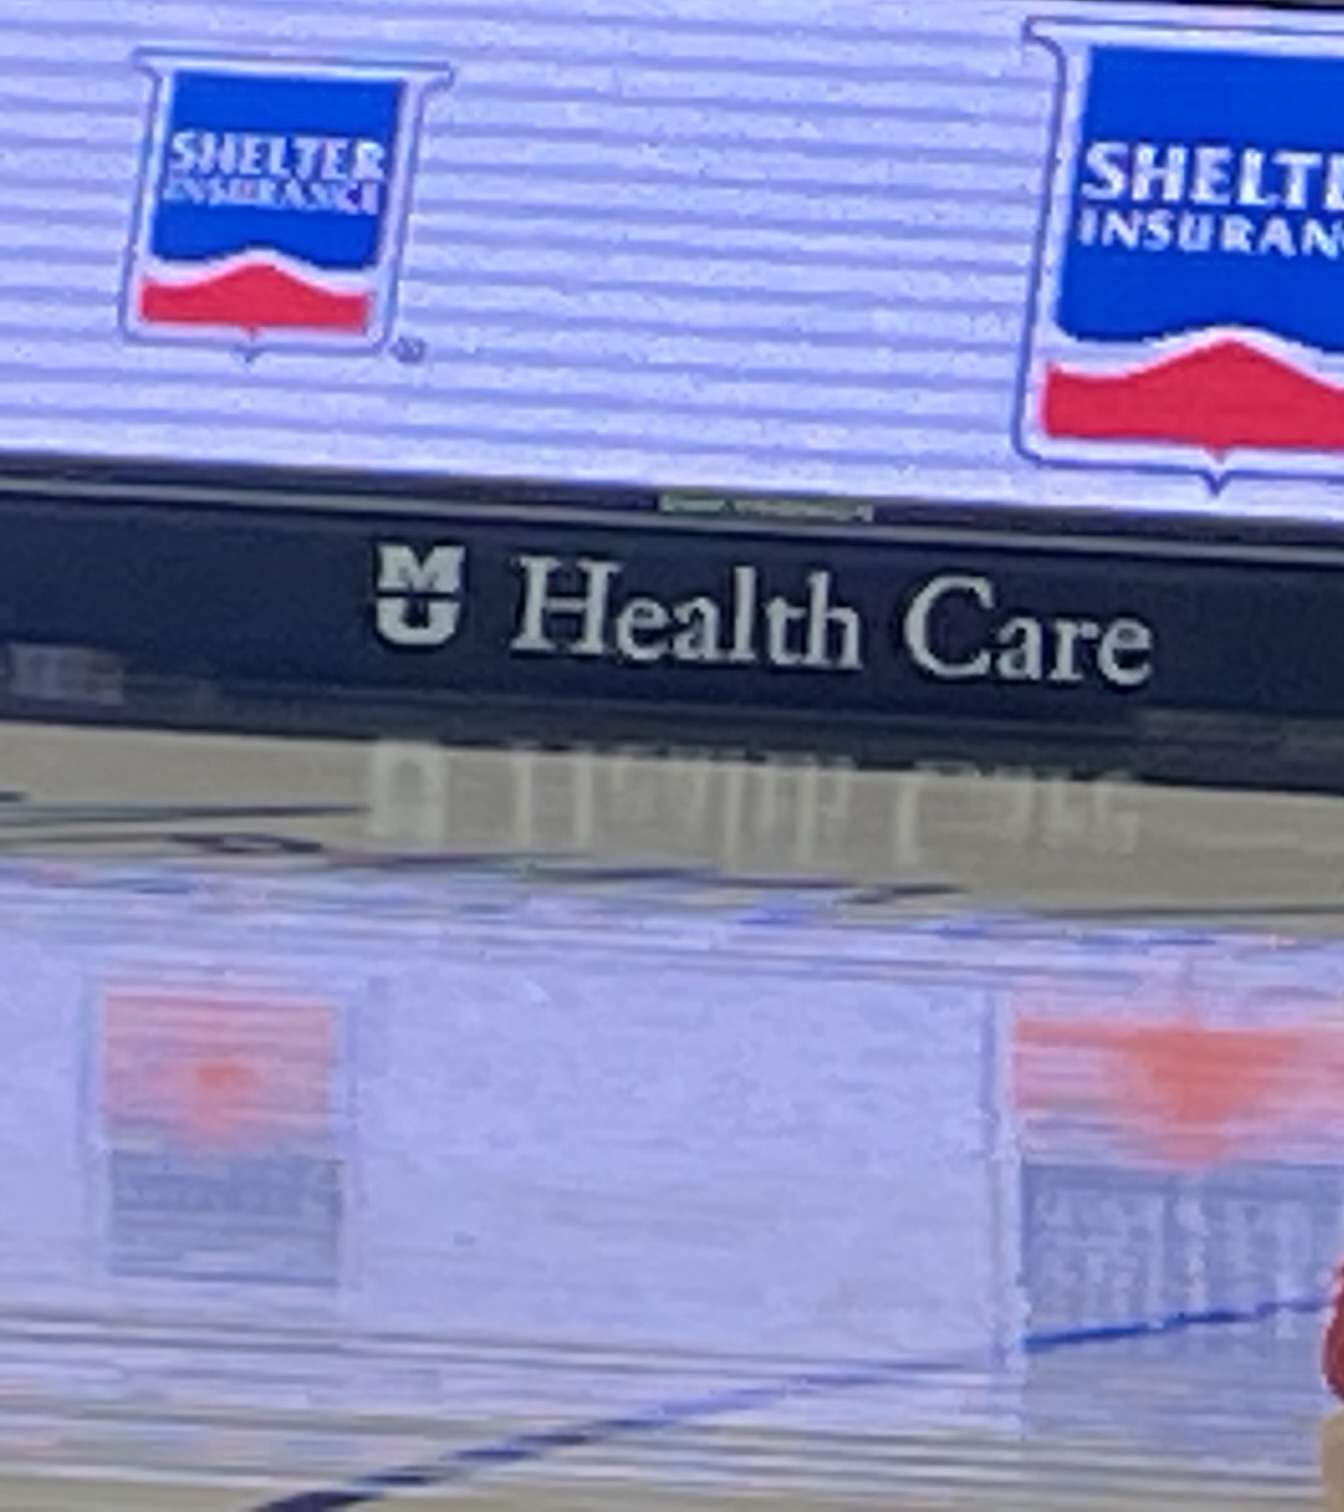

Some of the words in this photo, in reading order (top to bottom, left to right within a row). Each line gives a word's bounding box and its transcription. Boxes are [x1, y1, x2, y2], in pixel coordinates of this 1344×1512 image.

[168, 127, 386, 181] SHELTER
[509, 554, 863, 671] Health
[903, 574, 1155, 685] Care
